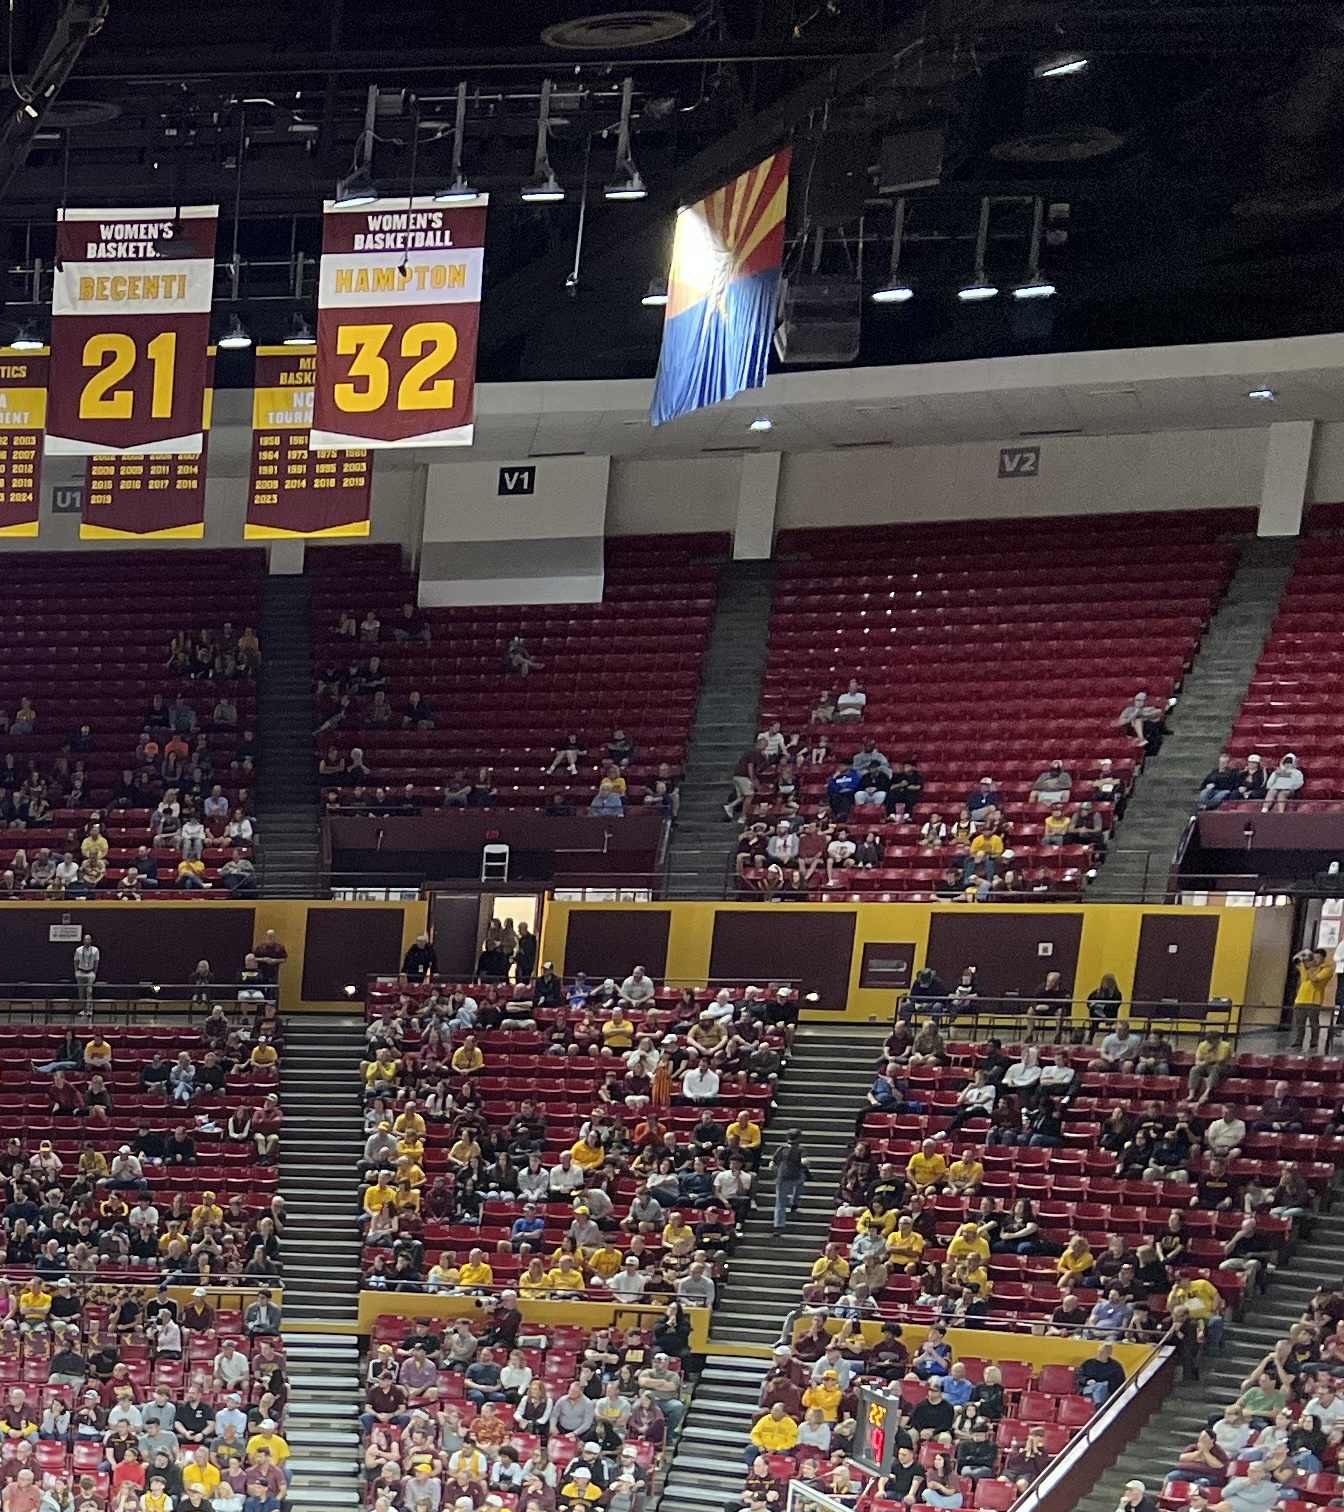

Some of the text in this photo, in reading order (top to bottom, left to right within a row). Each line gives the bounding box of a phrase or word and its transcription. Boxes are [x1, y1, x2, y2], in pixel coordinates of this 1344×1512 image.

[99, 222, 174, 240] WOMEN'S
[367, 212, 443, 232] WOMEN'S
[353, 230, 453, 251] BASKETBALL
[79, 274, 187, 301] BECENTI
[334, 263, 467, 294] HAMPTON
[79, 331, 177, 420] 21
[333, 321, 458, 413] 32
[1001, 451, 1036, 475] V2
[503, 471, 533, 492] V1
[56, 491, 81, 508] U1
